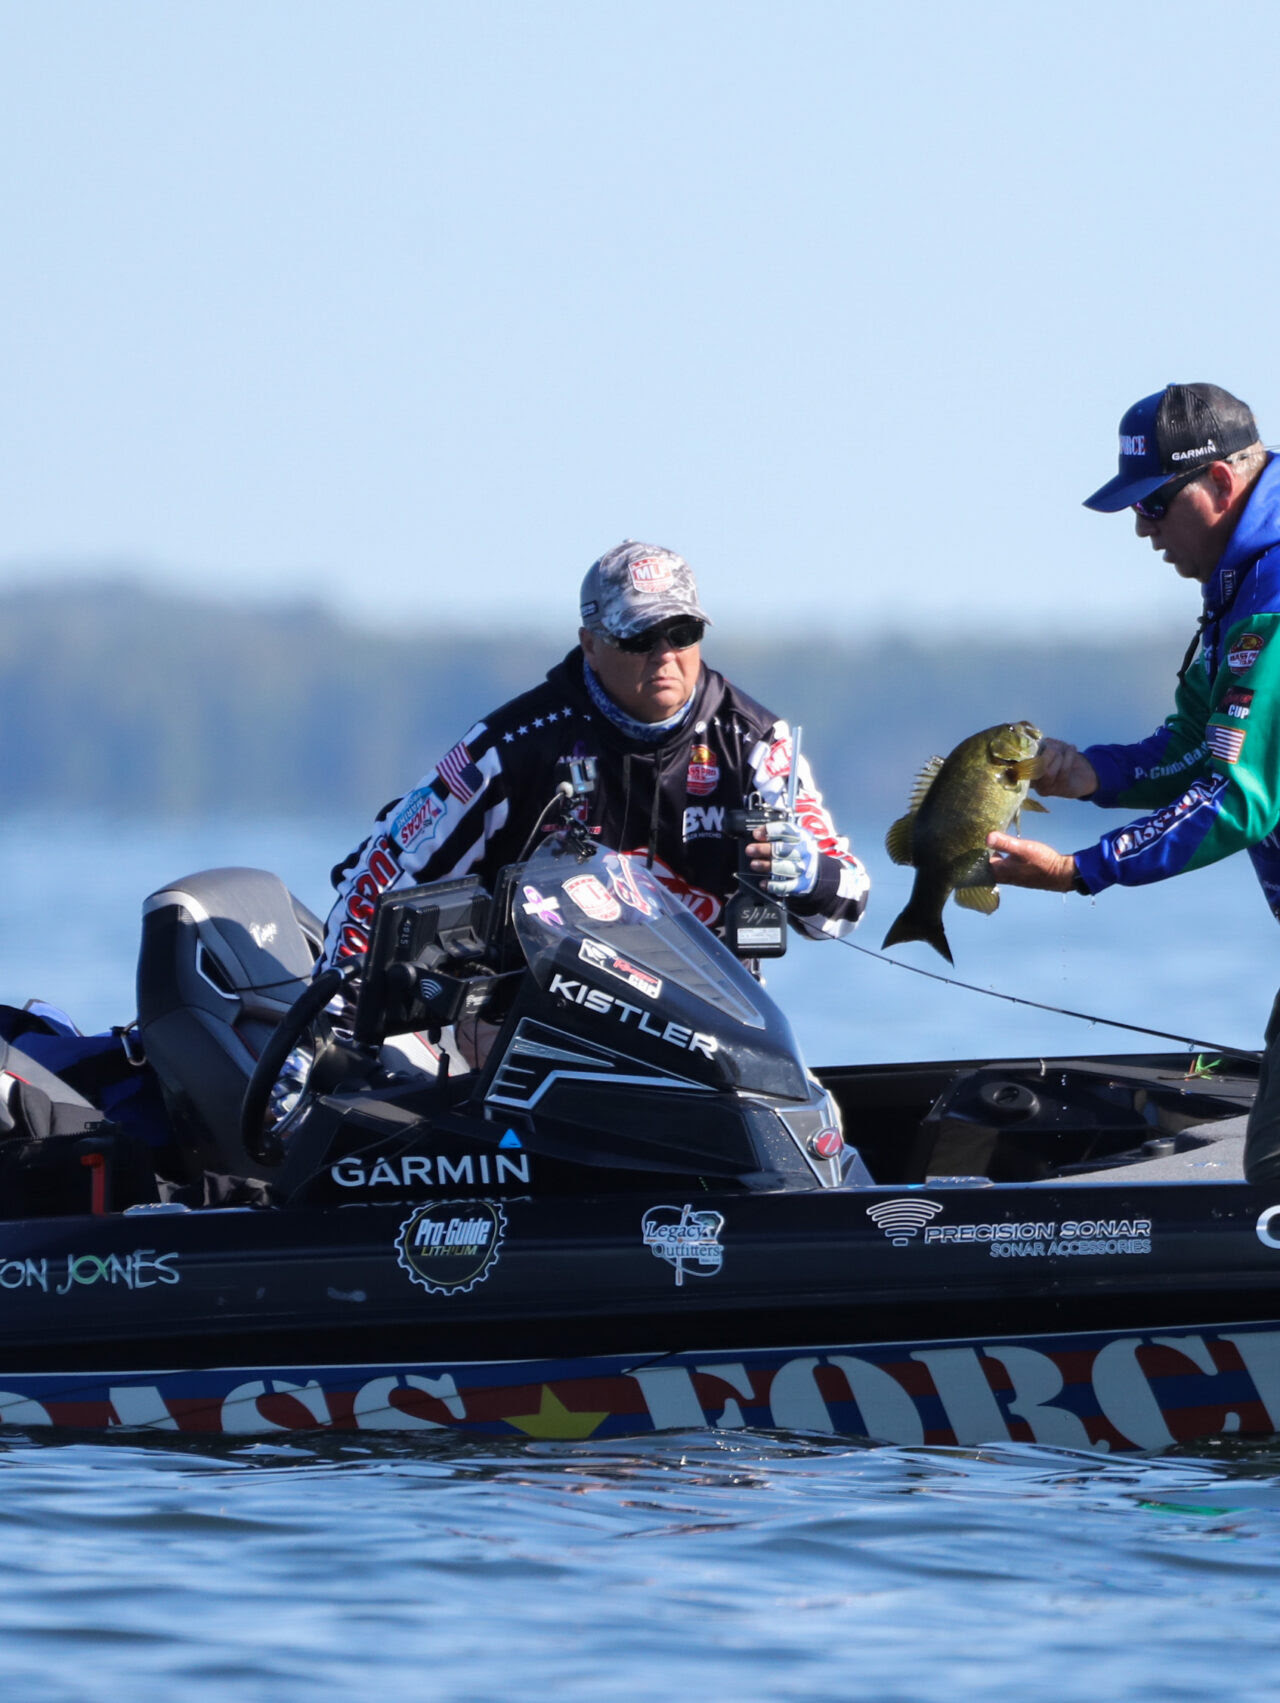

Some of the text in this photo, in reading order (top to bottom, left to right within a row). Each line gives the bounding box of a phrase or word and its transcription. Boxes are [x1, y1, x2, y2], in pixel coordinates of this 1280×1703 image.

[1171, 443, 1216, 461] GARMIN
[1228, 703, 1250, 720] CUP
[400, 798, 432, 845] LUCAS
[549, 974, 719, 1061] KISTLER
[331, 1153, 531, 1187] GARMIN
[414, 1218, 491, 1247] Pro-Guide
[645, 1221, 706, 1243] Legacy
[925, 1219, 1152, 1244] PRECISION SONAR
[421, 1245, 478, 1257] LITHIUM
[652, 1243, 721, 1257] Outfitters
[989, 1238, 1152, 1258] SONAR ACCESSORIES
[0, 1249, 181, 1295] ON JONES
